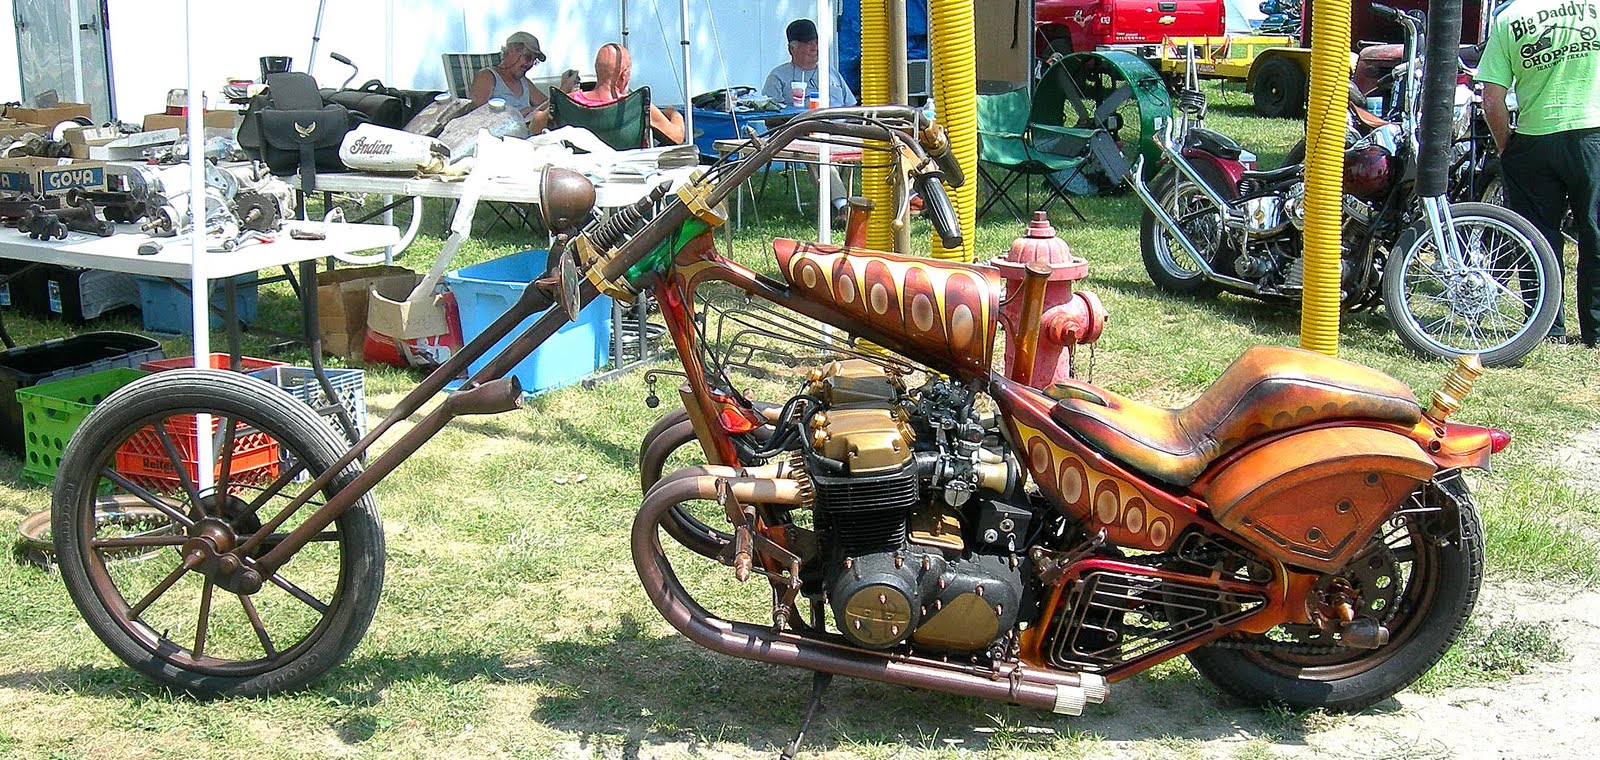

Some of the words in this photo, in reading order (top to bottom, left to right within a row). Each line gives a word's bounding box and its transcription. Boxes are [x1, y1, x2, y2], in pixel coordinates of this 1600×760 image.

[1510, 16, 1537, 42] Big
[1536, 0, 1598, 24] Daddy's
[1522, 40, 1600, 69] CHOPPERS
[349, 136, 393, 156] Indian
[49, 169, 94, 188] GOYA
